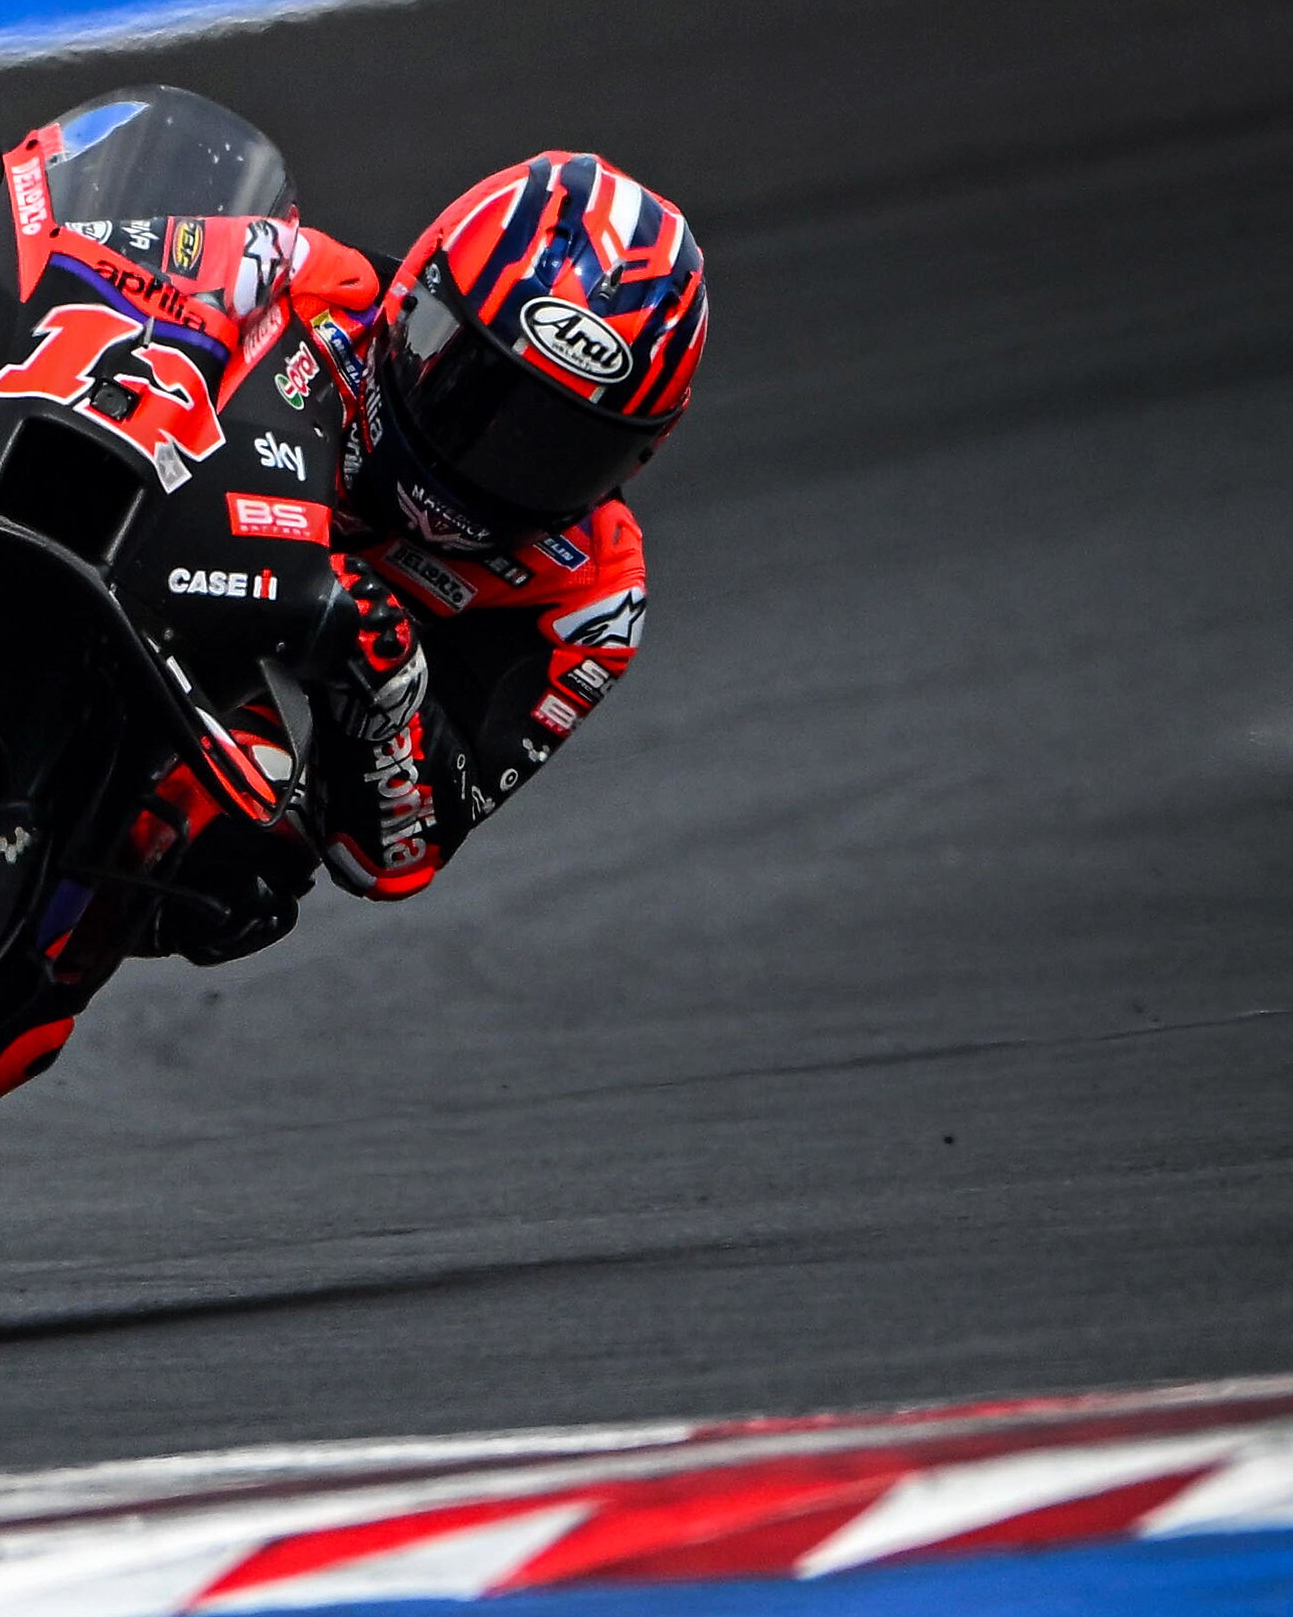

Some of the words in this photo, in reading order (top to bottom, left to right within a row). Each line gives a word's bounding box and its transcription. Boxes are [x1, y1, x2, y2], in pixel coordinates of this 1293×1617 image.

[93, 259, 207, 332] aprilia
[533, 314, 622, 368] Arai
[253, 431, 307, 482] sky
[235, 498, 308, 529] BS
[167, 566, 248, 598] CASE
